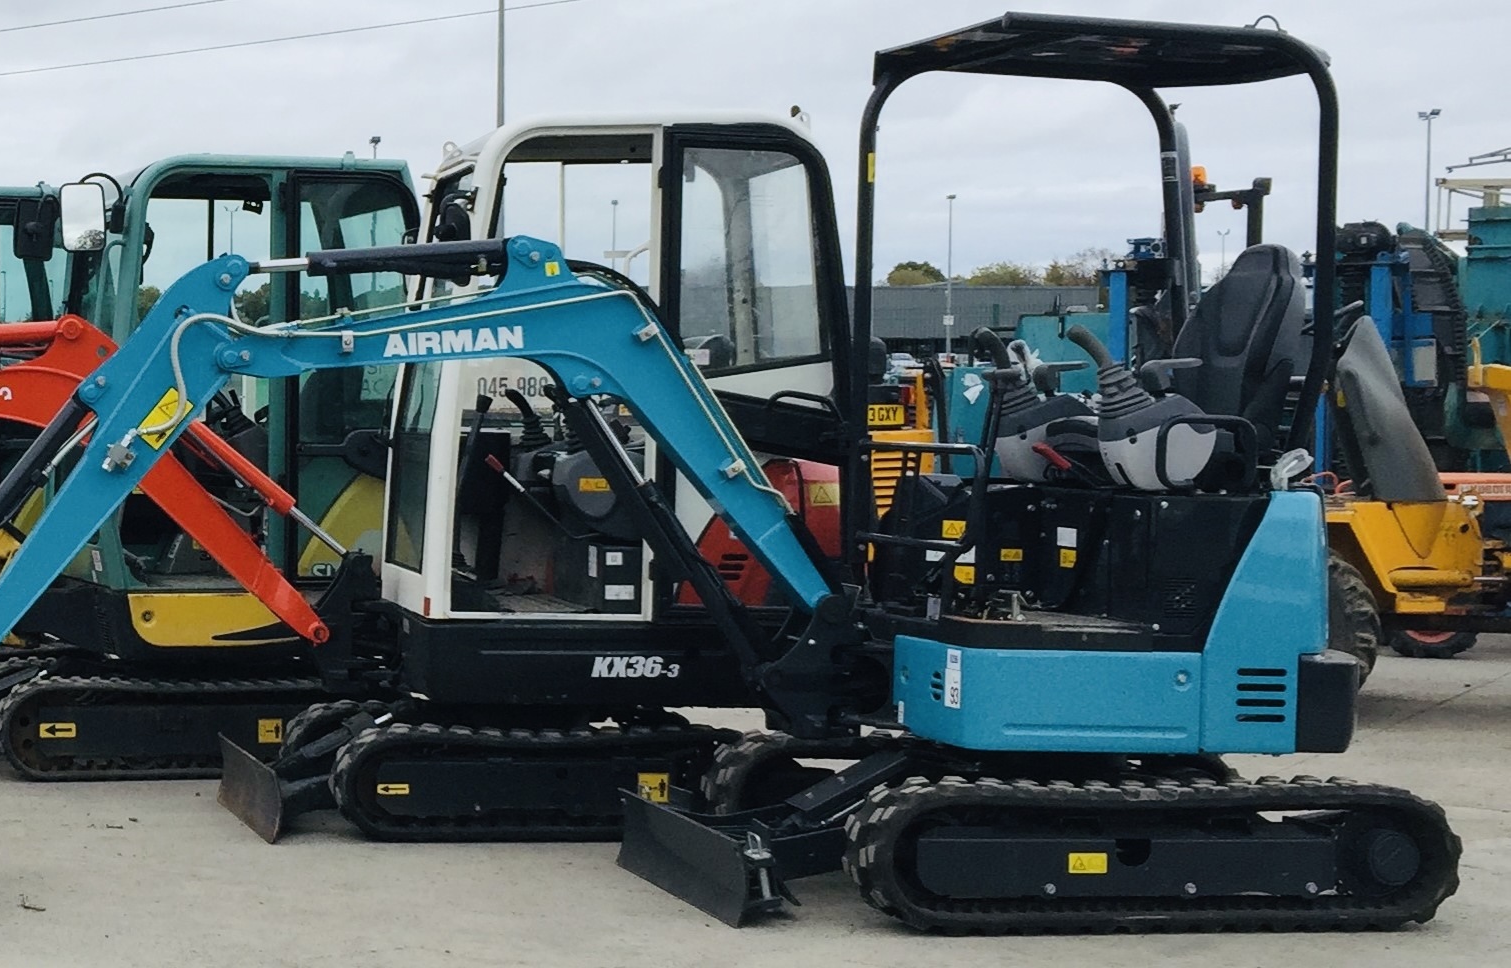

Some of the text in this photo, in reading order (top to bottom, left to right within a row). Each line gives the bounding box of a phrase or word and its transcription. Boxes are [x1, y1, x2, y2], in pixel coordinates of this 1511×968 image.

[383, 326, 525, 358] AIRMAN
[878, 407, 898, 422] GXY
[591, 656, 680, 678] KX36-3
